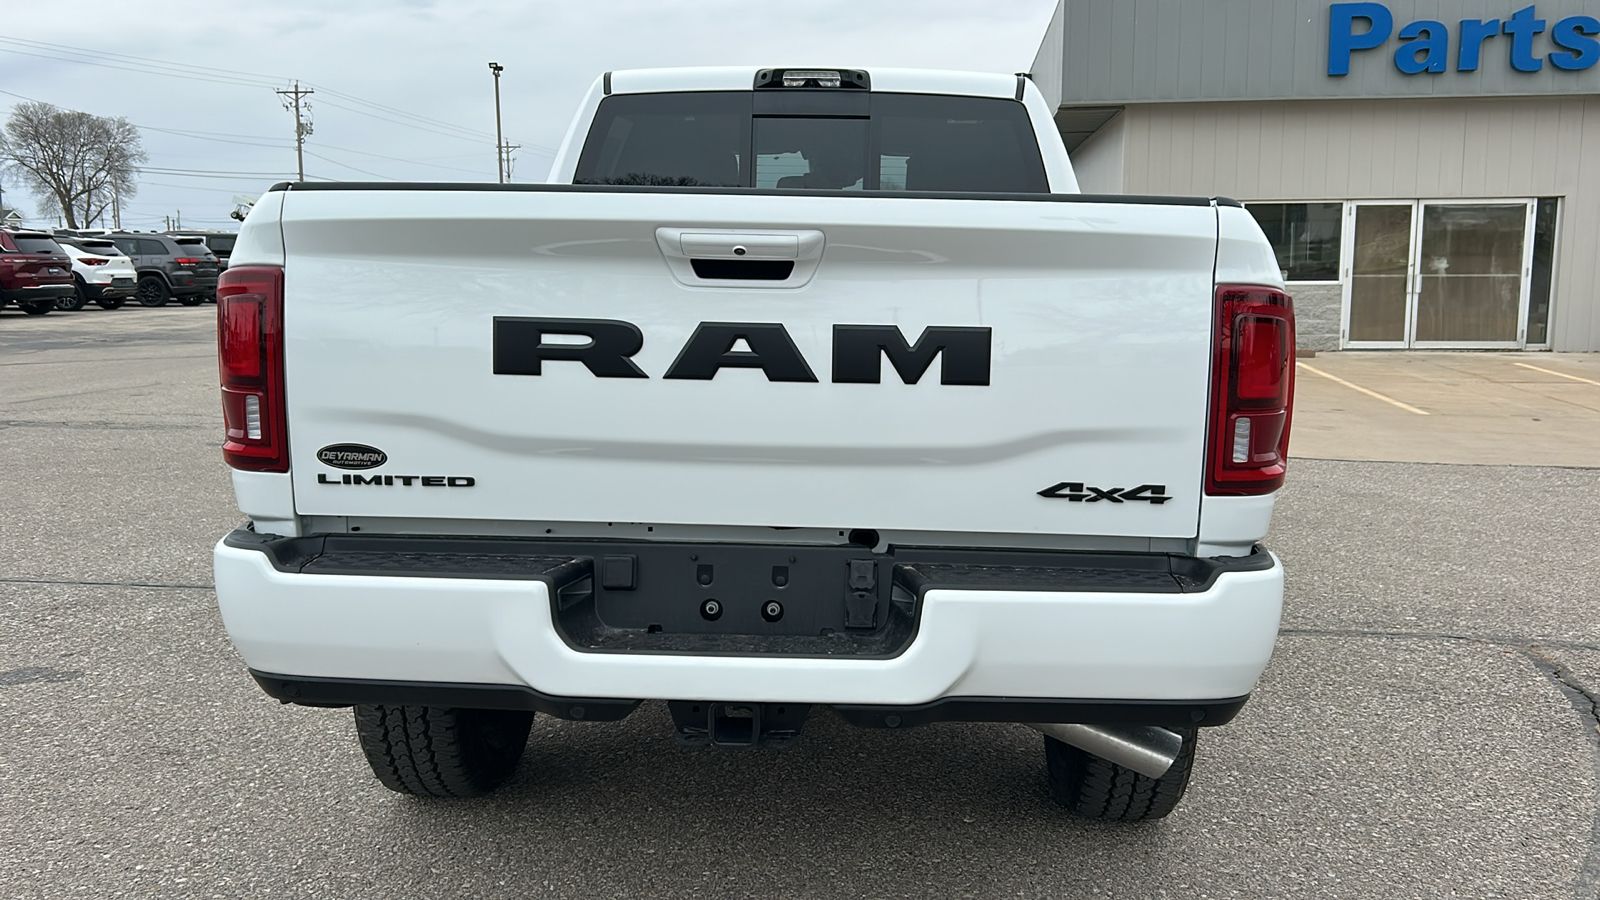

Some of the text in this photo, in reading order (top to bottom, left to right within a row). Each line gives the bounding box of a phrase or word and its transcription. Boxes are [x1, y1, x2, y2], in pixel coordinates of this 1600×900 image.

[1327, 2, 1600, 76] Parts
[493, 316, 992, 386] RAM
[321, 451, 383, 462] DEYARMAN
[317, 473, 476, 488] LIMITED
[1036, 481, 1174, 505] 4x4
